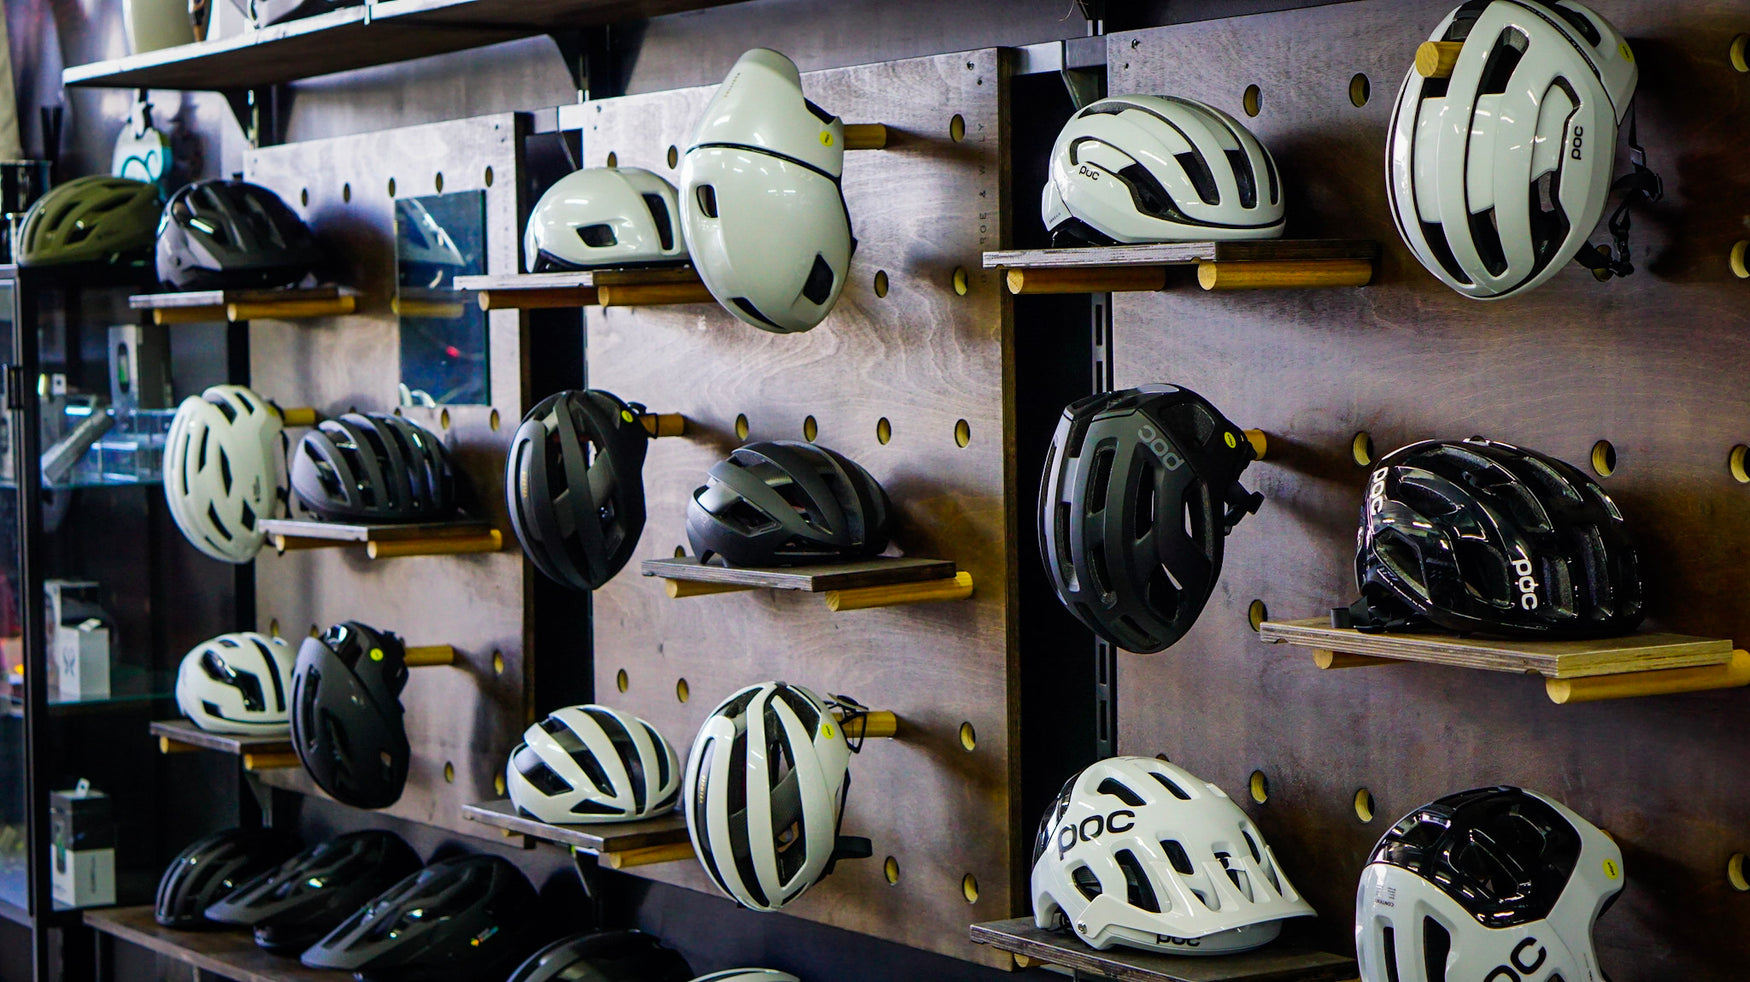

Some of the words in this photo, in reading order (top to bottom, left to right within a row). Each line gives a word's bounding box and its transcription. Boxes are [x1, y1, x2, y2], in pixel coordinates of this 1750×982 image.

[1571, 125, 1584, 160] poc
[1138, 425, 1185, 472] poc
[1370, 466, 1389, 515] poc
[1511, 559, 1538, 611] poc
[1057, 809, 1136, 862] poc
